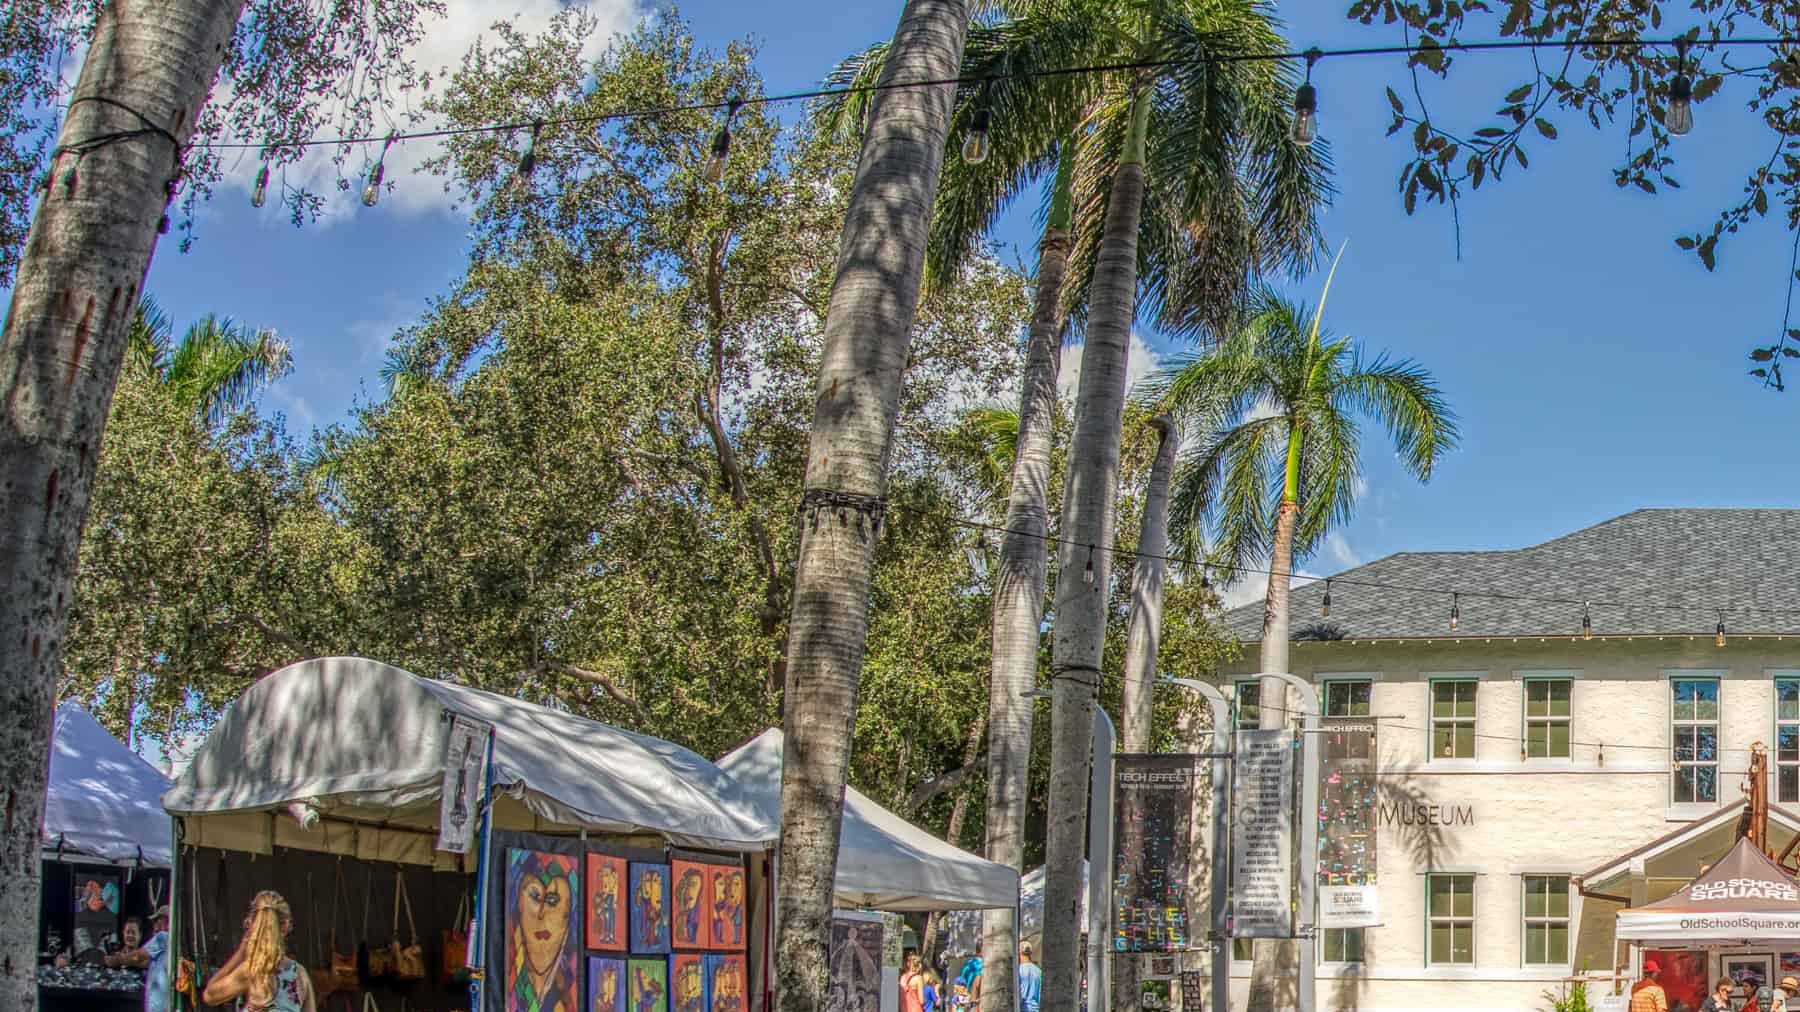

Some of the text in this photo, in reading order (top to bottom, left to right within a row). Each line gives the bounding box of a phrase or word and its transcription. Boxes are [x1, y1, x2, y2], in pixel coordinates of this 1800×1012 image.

[1119, 773, 1146, 782] TECH
[1379, 802, 1474, 825] MUSEUM
[1692, 878, 1793, 892] OLD SCHOOL
